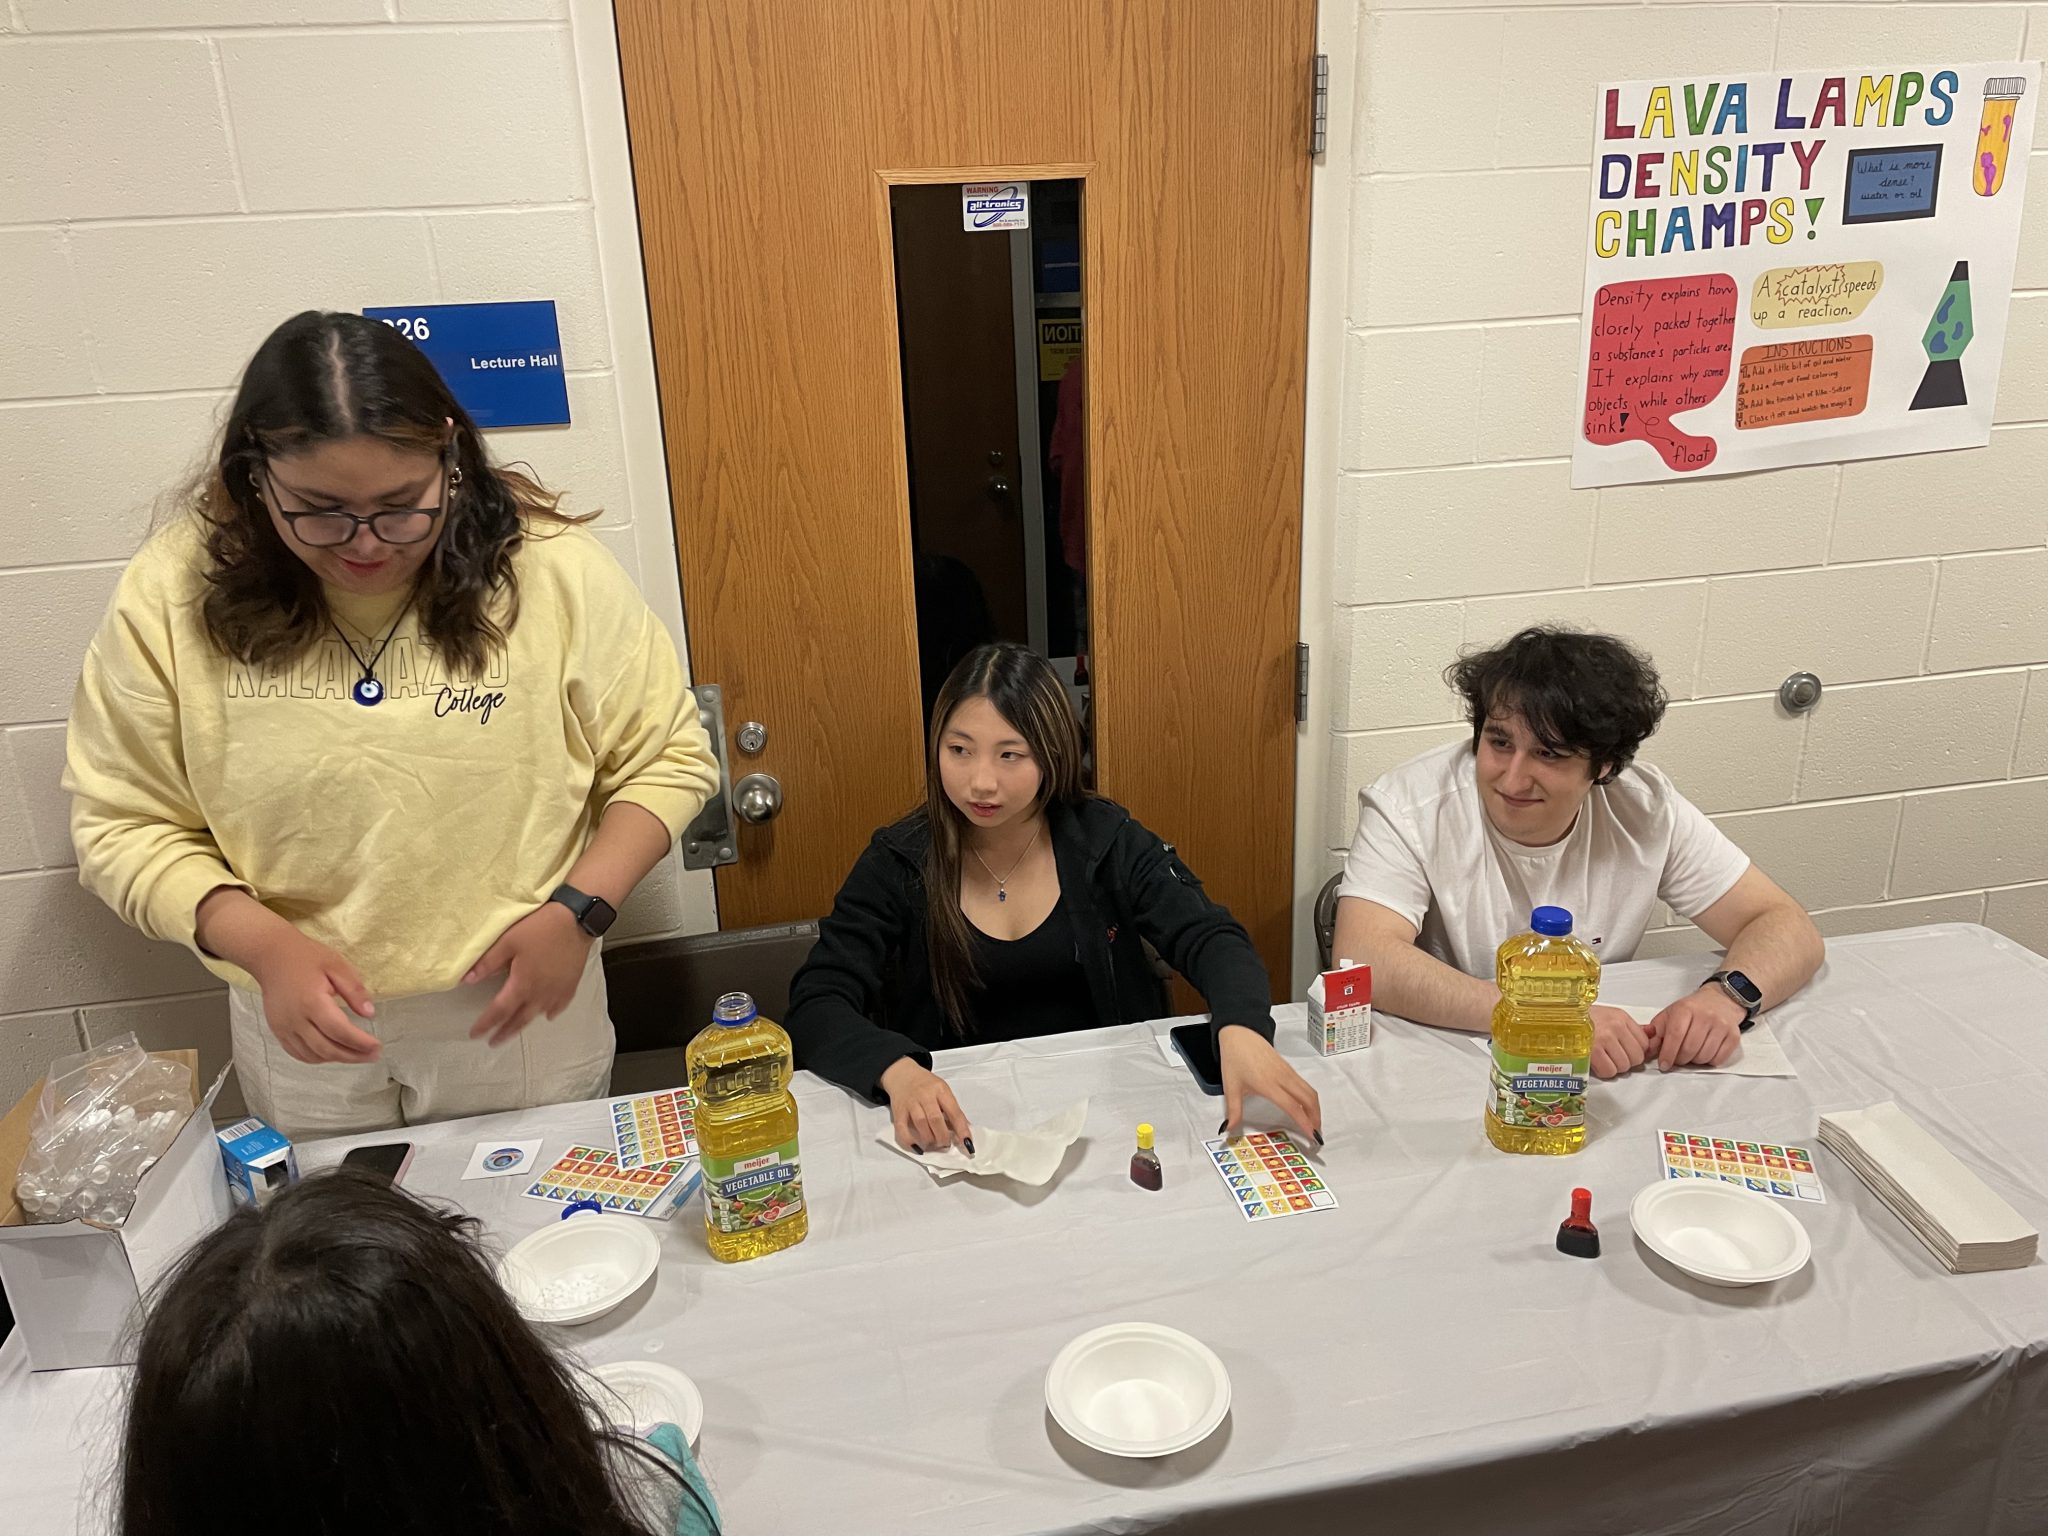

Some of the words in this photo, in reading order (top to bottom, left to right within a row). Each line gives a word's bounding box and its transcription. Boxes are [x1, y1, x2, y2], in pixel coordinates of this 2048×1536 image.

[1604, 83, 1748, 140] LAVA
[1774, 70, 1959, 131] LAMPS
[1599, 140, 1826, 200] DENSITY
[1857, 160, 1883, 174] What
[1888, 161, 1899, 170] is
[1903, 161, 1931, 170] more
[966, 186, 999, 195] WARNING
[1878, 175, 1915, 187] dense?
[1861, 192, 1888, 200] water
[1910, 188, 1922, 198] oil
[1595, 197, 1825, 258] CHAMPS!
[1599, 284, 1653, 312] Density
[1661, 283, 1700, 305] explains
[1708, 278, 1734, 295] how
[1757, 275, 1770, 298] A
[1782, 271, 1840, 299] catalyst
[1844, 269, 1877, 299] speeds
[1594, 313, 1644, 341] closely
[1654, 312, 1691, 338] packed
[1696, 307, 1735, 333] together
[1753, 311, 1768, 326] up
[1778, 310, 1785, 319] a
[1798, 299, 1852, 319] reaction.
[1592, 351, 1600, 361] a
[1607, 341, 1664, 362] substance's
[1673, 339, 1710, 362] particles
[1715, 343, 1732, 352] are.
[1762, 337, 1853, 360] INSTRUCTIONS
[471, 357, 526, 370] Lecture
[530, 354, 558, 367] Hall
[1752, 366, 1765, 376] Add
[1774, 363, 1789, 373] little
[1792, 362, 1802, 370] bit
[1804, 360, 1812, 368] of
[1813, 358, 1822, 367] oil
[1823, 357, 1834, 365] and
[1592, 368, 1615, 388] It
[1625, 367, 1673, 388] explains
[1680, 365, 1699, 382] why
[1703, 367, 1724, 379] some
[1738, 382, 1749, 395] 2.
[1751, 383, 1764, 393] Add
[1797, 375, 1810, 383] food
[1812, 371, 1839, 380] coloring
[1588, 394, 1628, 415] objects
[1640, 391, 1668, 409] while
[1675, 387, 1708, 404] others
[1738, 398, 1749, 412] 3.
[1751, 399, 1763, 409] Add
[1807, 391, 1814, 399] of
[1585, 412, 1630, 435] sink!
[1736, 412, 1747, 427] 4.
[1749, 414, 1769, 424] Close
[1770, 411, 1776, 420] it
[1777, 410, 1786, 418] off
[1788, 408, 1800, 416] and
[1673, 443, 1711, 464] float
[434, 686, 506, 725] College
[1537, 1065, 1563, 1073] meijer
[1516, 1080, 1564, 1089] VEGETABLE
[1567, 1081, 1580, 1090] OIL
[743, 1156, 770, 1170] meijer
[725, 1171, 775, 1194] VEGETABLE
[777, 1167, 792, 1179] OIL
